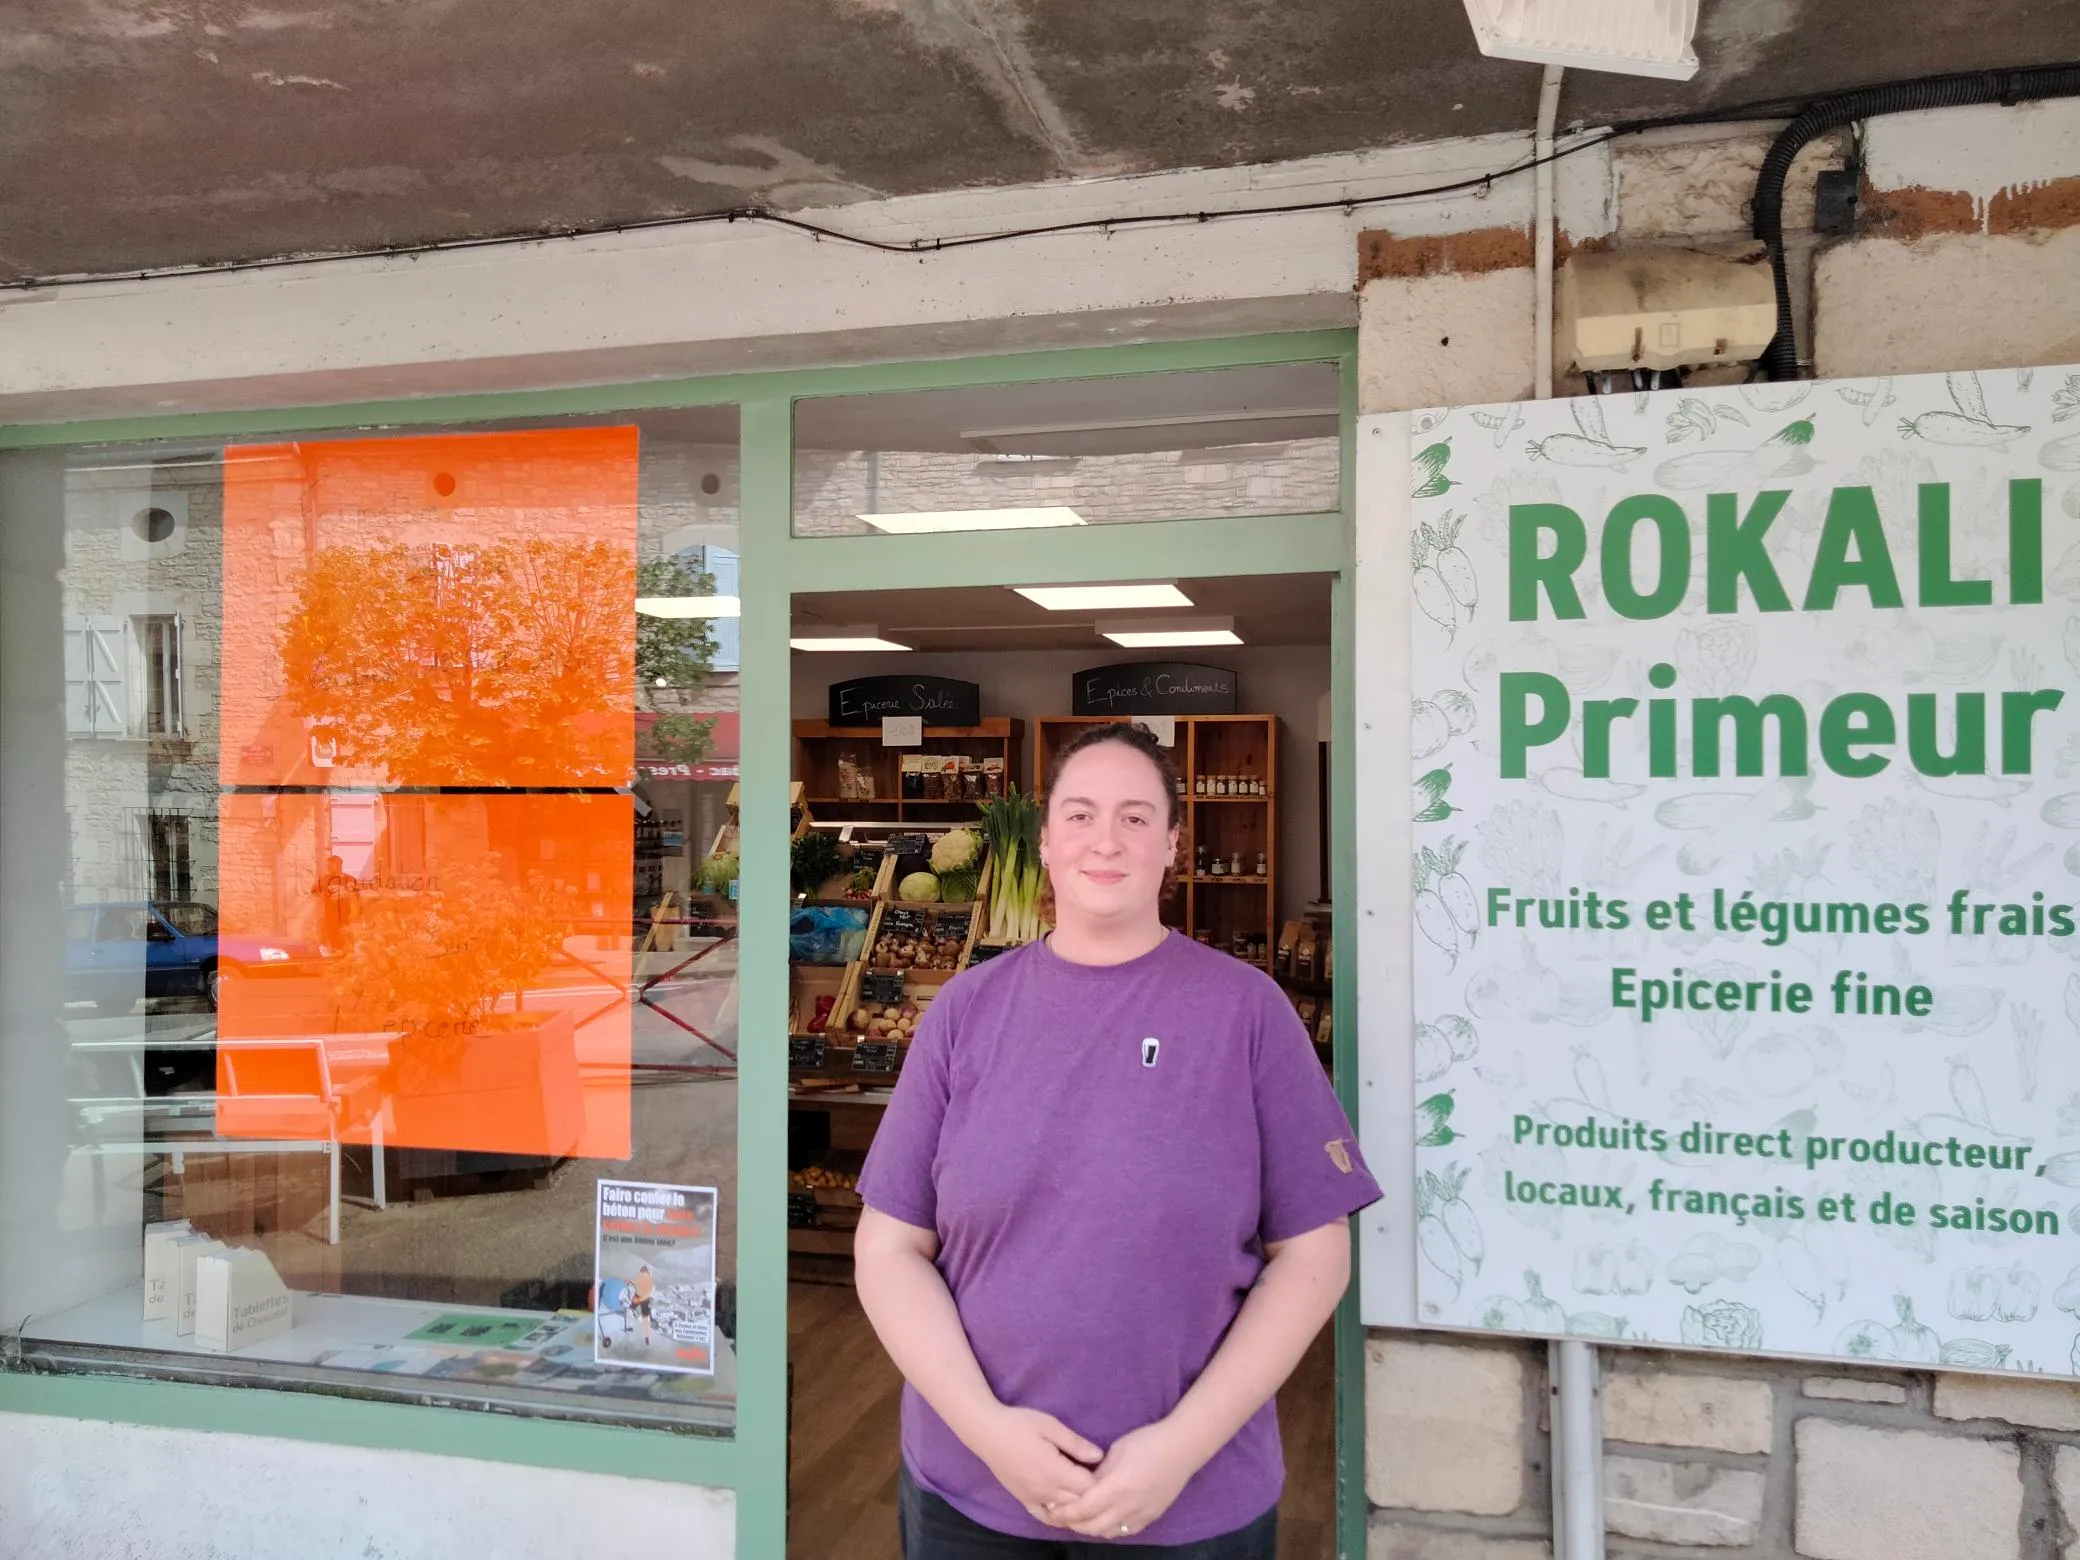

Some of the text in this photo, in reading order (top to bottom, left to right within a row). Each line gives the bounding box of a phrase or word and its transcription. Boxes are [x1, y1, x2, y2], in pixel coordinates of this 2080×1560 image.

[1508, 477, 2044, 622] ROKALI
[840, 687, 901, 720] Epicerie
[1086, 677, 1138, 707] Epices
[1140, 677, 1154, 698] &
[1500, 662, 2065, 779] Primeur
[1487, 887, 2076, 946] Fruits et légumes frais
[1612, 967, 1934, 1022] Epicerie fine
[1514, 1114, 2048, 1176] Produits direct producteur,
[603, 1187, 631, 1203] Faire
[1505, 1171, 2060, 1236] locaux, français et de saison
